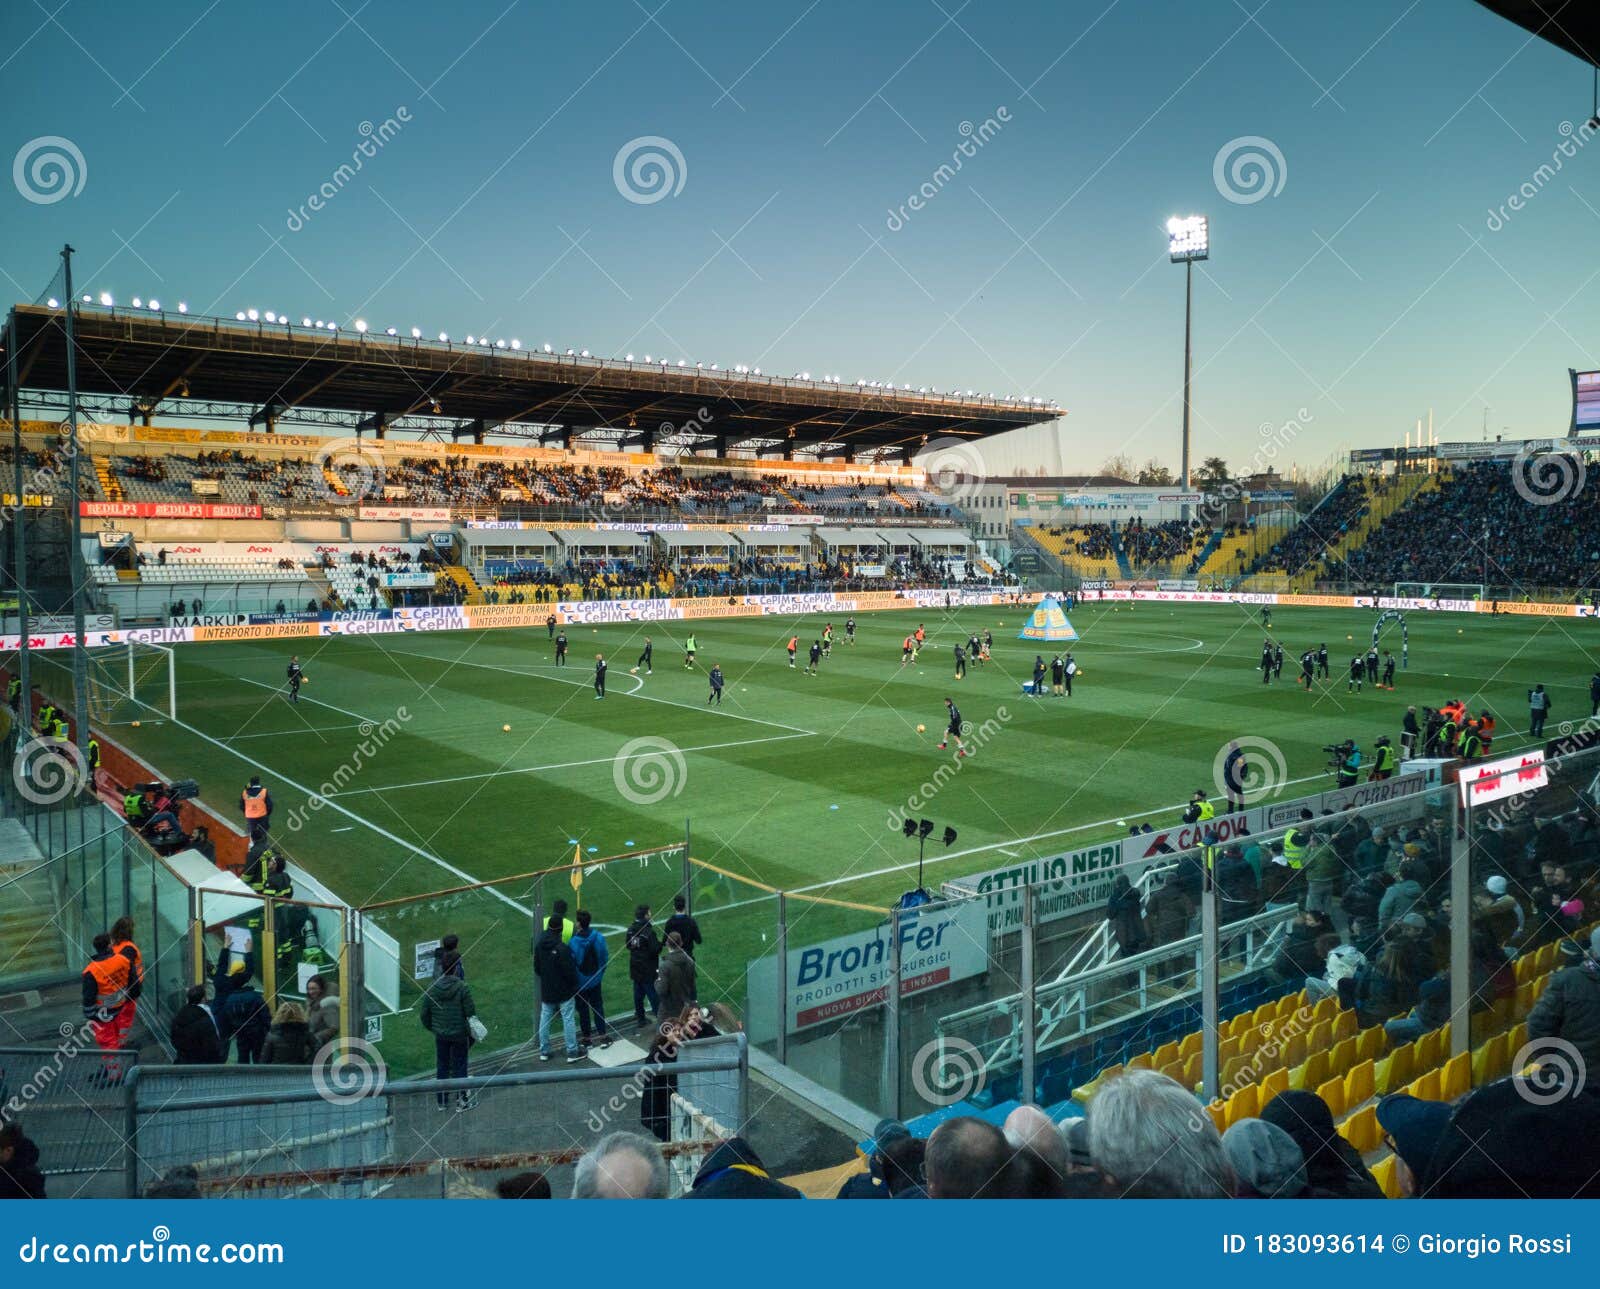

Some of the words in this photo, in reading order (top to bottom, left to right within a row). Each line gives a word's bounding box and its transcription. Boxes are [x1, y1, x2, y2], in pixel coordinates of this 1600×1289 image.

[675, 598, 709, 606] INTERPORTO
[760, 595, 790, 605] CePIM
[803, 593, 832, 603] CePIM
[470, 605, 514, 616] INTERPORTO
[516, 605, 525, 615] DI
[526, 604, 550, 614] PARMA
[577, 602, 614, 613] CePIM
[631, 600, 666, 611] CePIM
[779, 604, 811, 613] CePIM
[824, 602, 853, 611] CePIM
[1482, 603, 1528, 613] INRPORTO
[1530, 604, 1538, 613] DI
[1541, 605, 1568, 614] PARMA
[332, 609, 381, 621] Cetilar
[413, 608, 458, 619] CePIM
[585, 611, 623, 622] CePIM
[641, 609, 679, 620] CePIM
[689, 608, 727, 616] INTERPORTO
[174, 614, 246, 627] MARKUP
[418, 617, 464, 631] CePIM
[476, 616, 520, 626] INTERPORTO
[523, 616, 532, 625] DI
[534, 615, 553, 624] PAR
[203, 626, 262, 639] INTERPORTO
[265, 626, 275, 636] DI
[278, 624, 310, 636] PARMA
[345, 620, 396, 634] CePIM
[127, 628, 187, 643] CePIM
[1178, 815, 1247, 850] CANOVI
[1072, 845, 1121, 886] NERI
[1006, 905, 1024, 927] PIAN
[796, 976, 864, 1006] PRODOTTI
[870, 952, 951, 983] SIRURGICI
[817, 1000, 851, 1017] NUOVA
[910, 976, 934, 989] INOX
